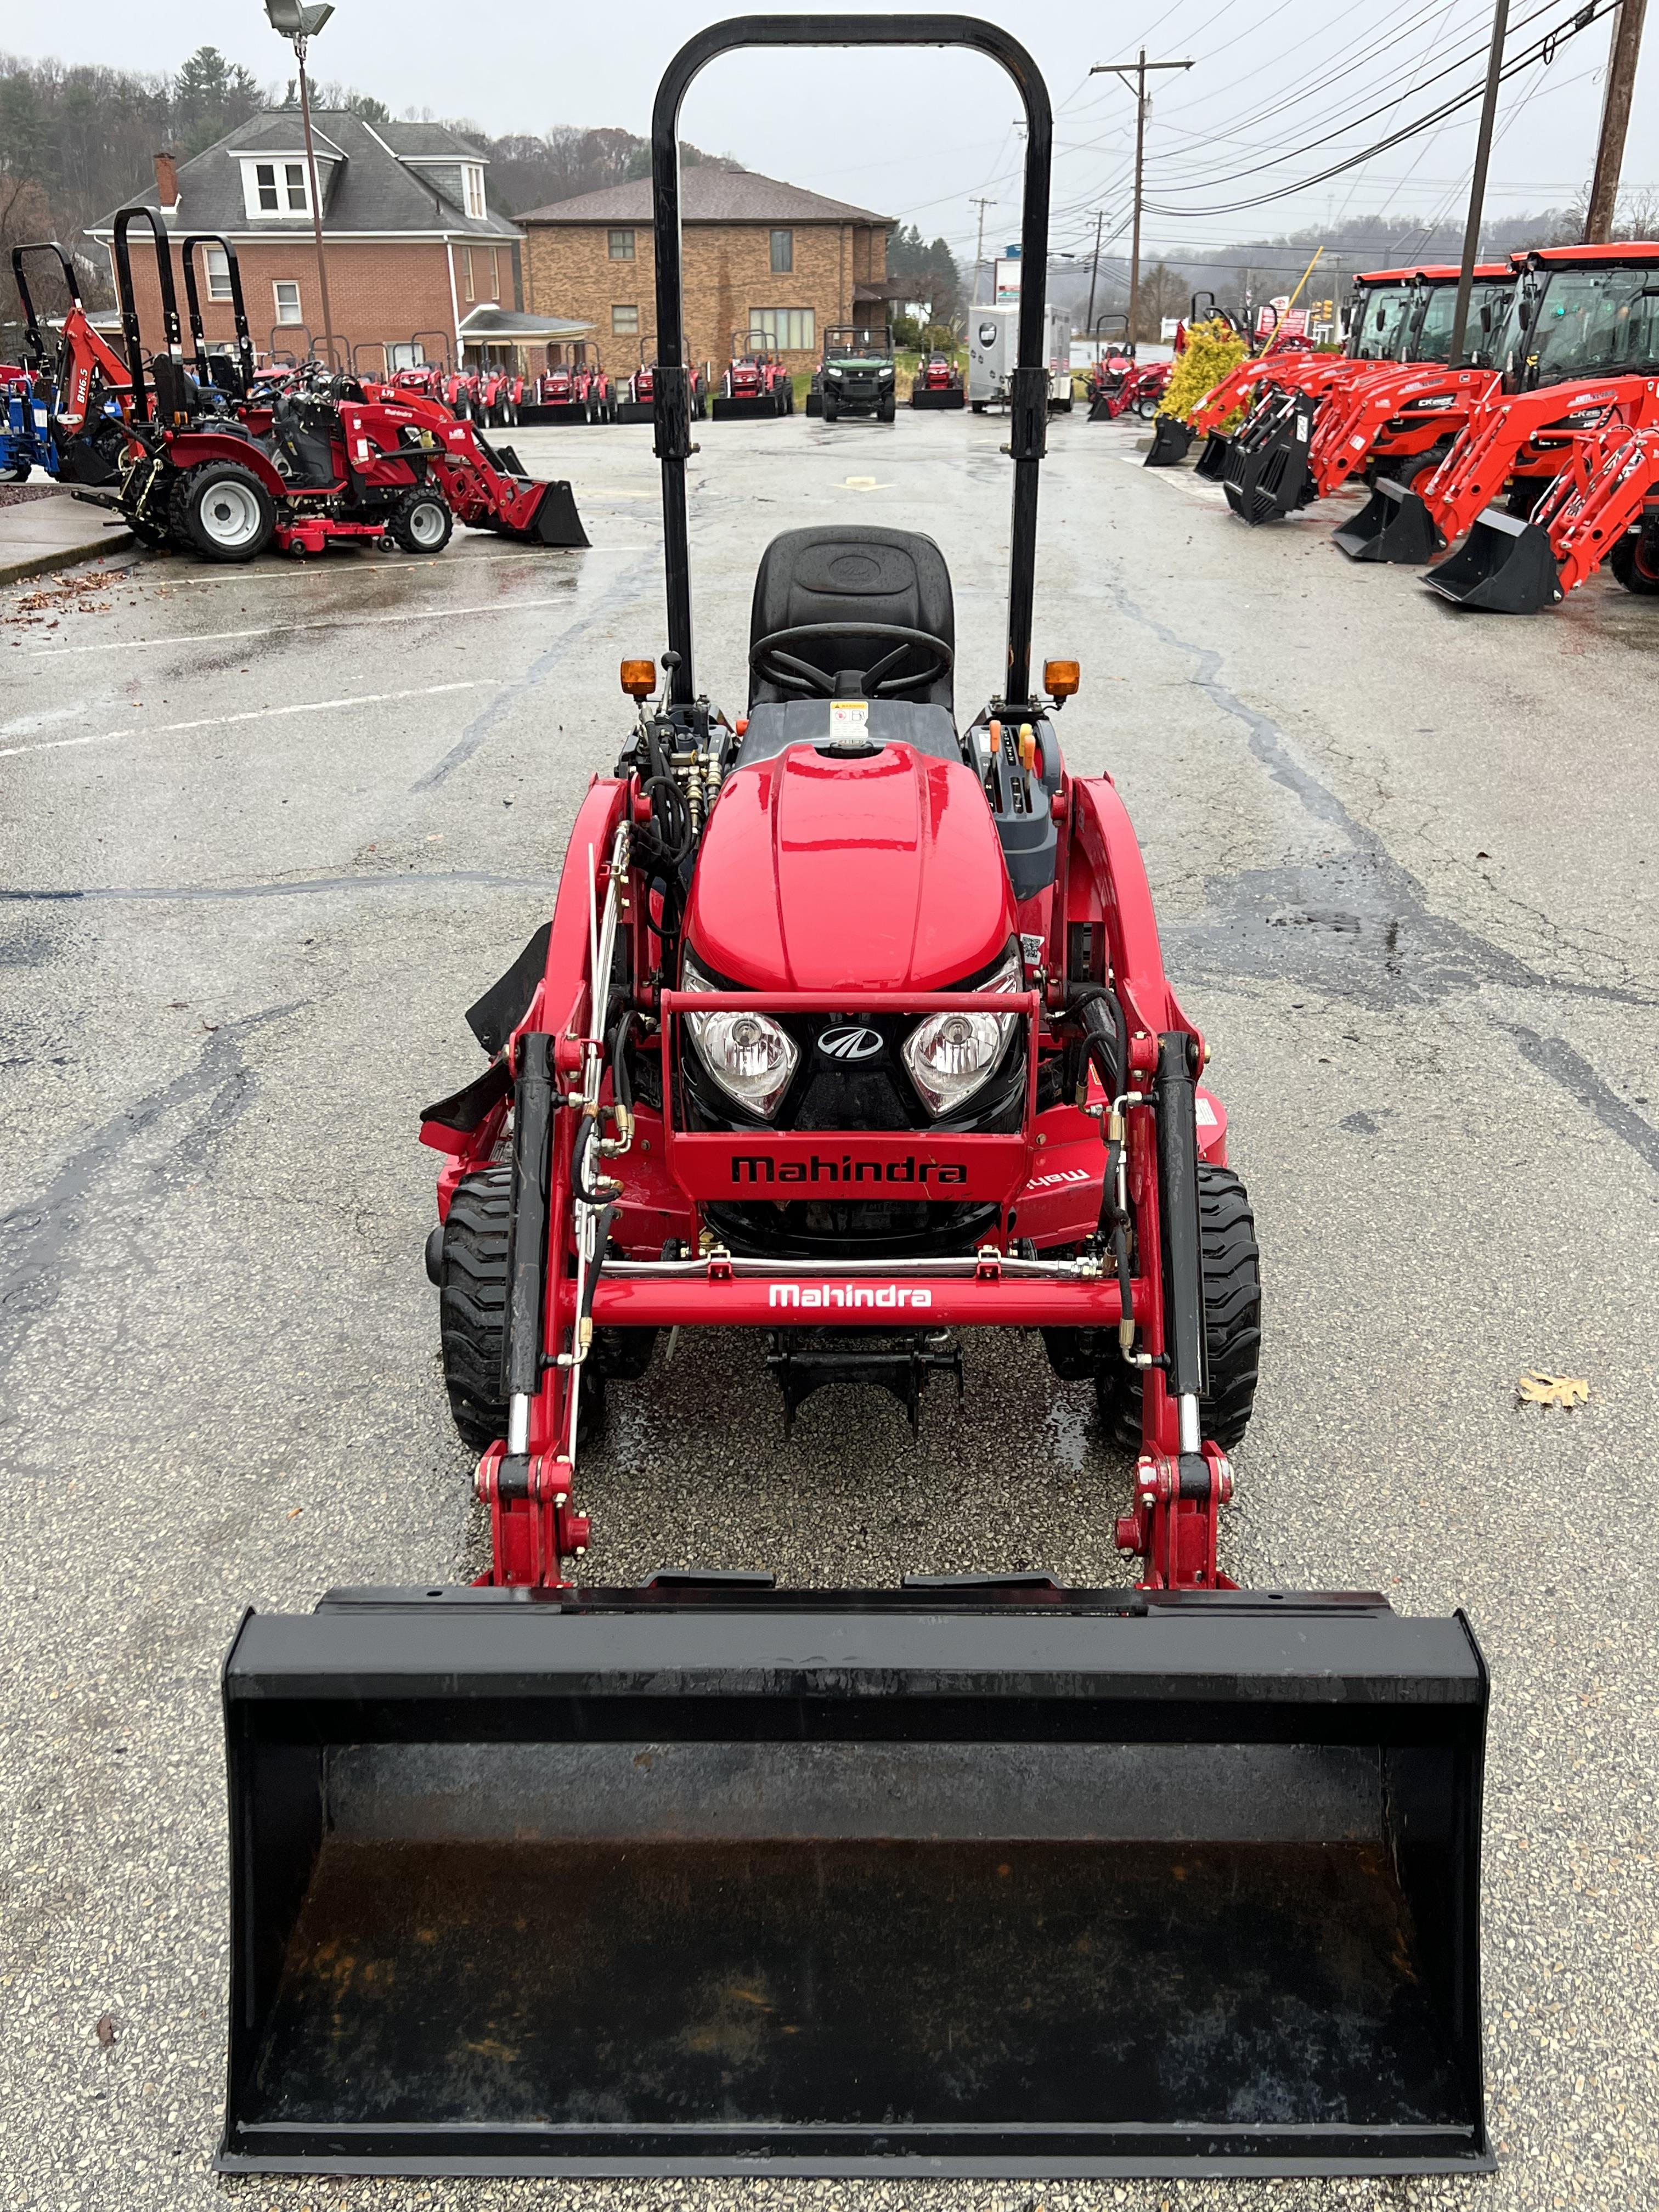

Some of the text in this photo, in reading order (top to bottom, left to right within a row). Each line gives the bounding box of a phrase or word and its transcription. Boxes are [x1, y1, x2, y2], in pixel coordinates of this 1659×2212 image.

[77, 368, 88, 404] BH6.5
[731, 1155, 967, 1184] Mahindra
[769, 1284, 932, 1307] Mahindra
